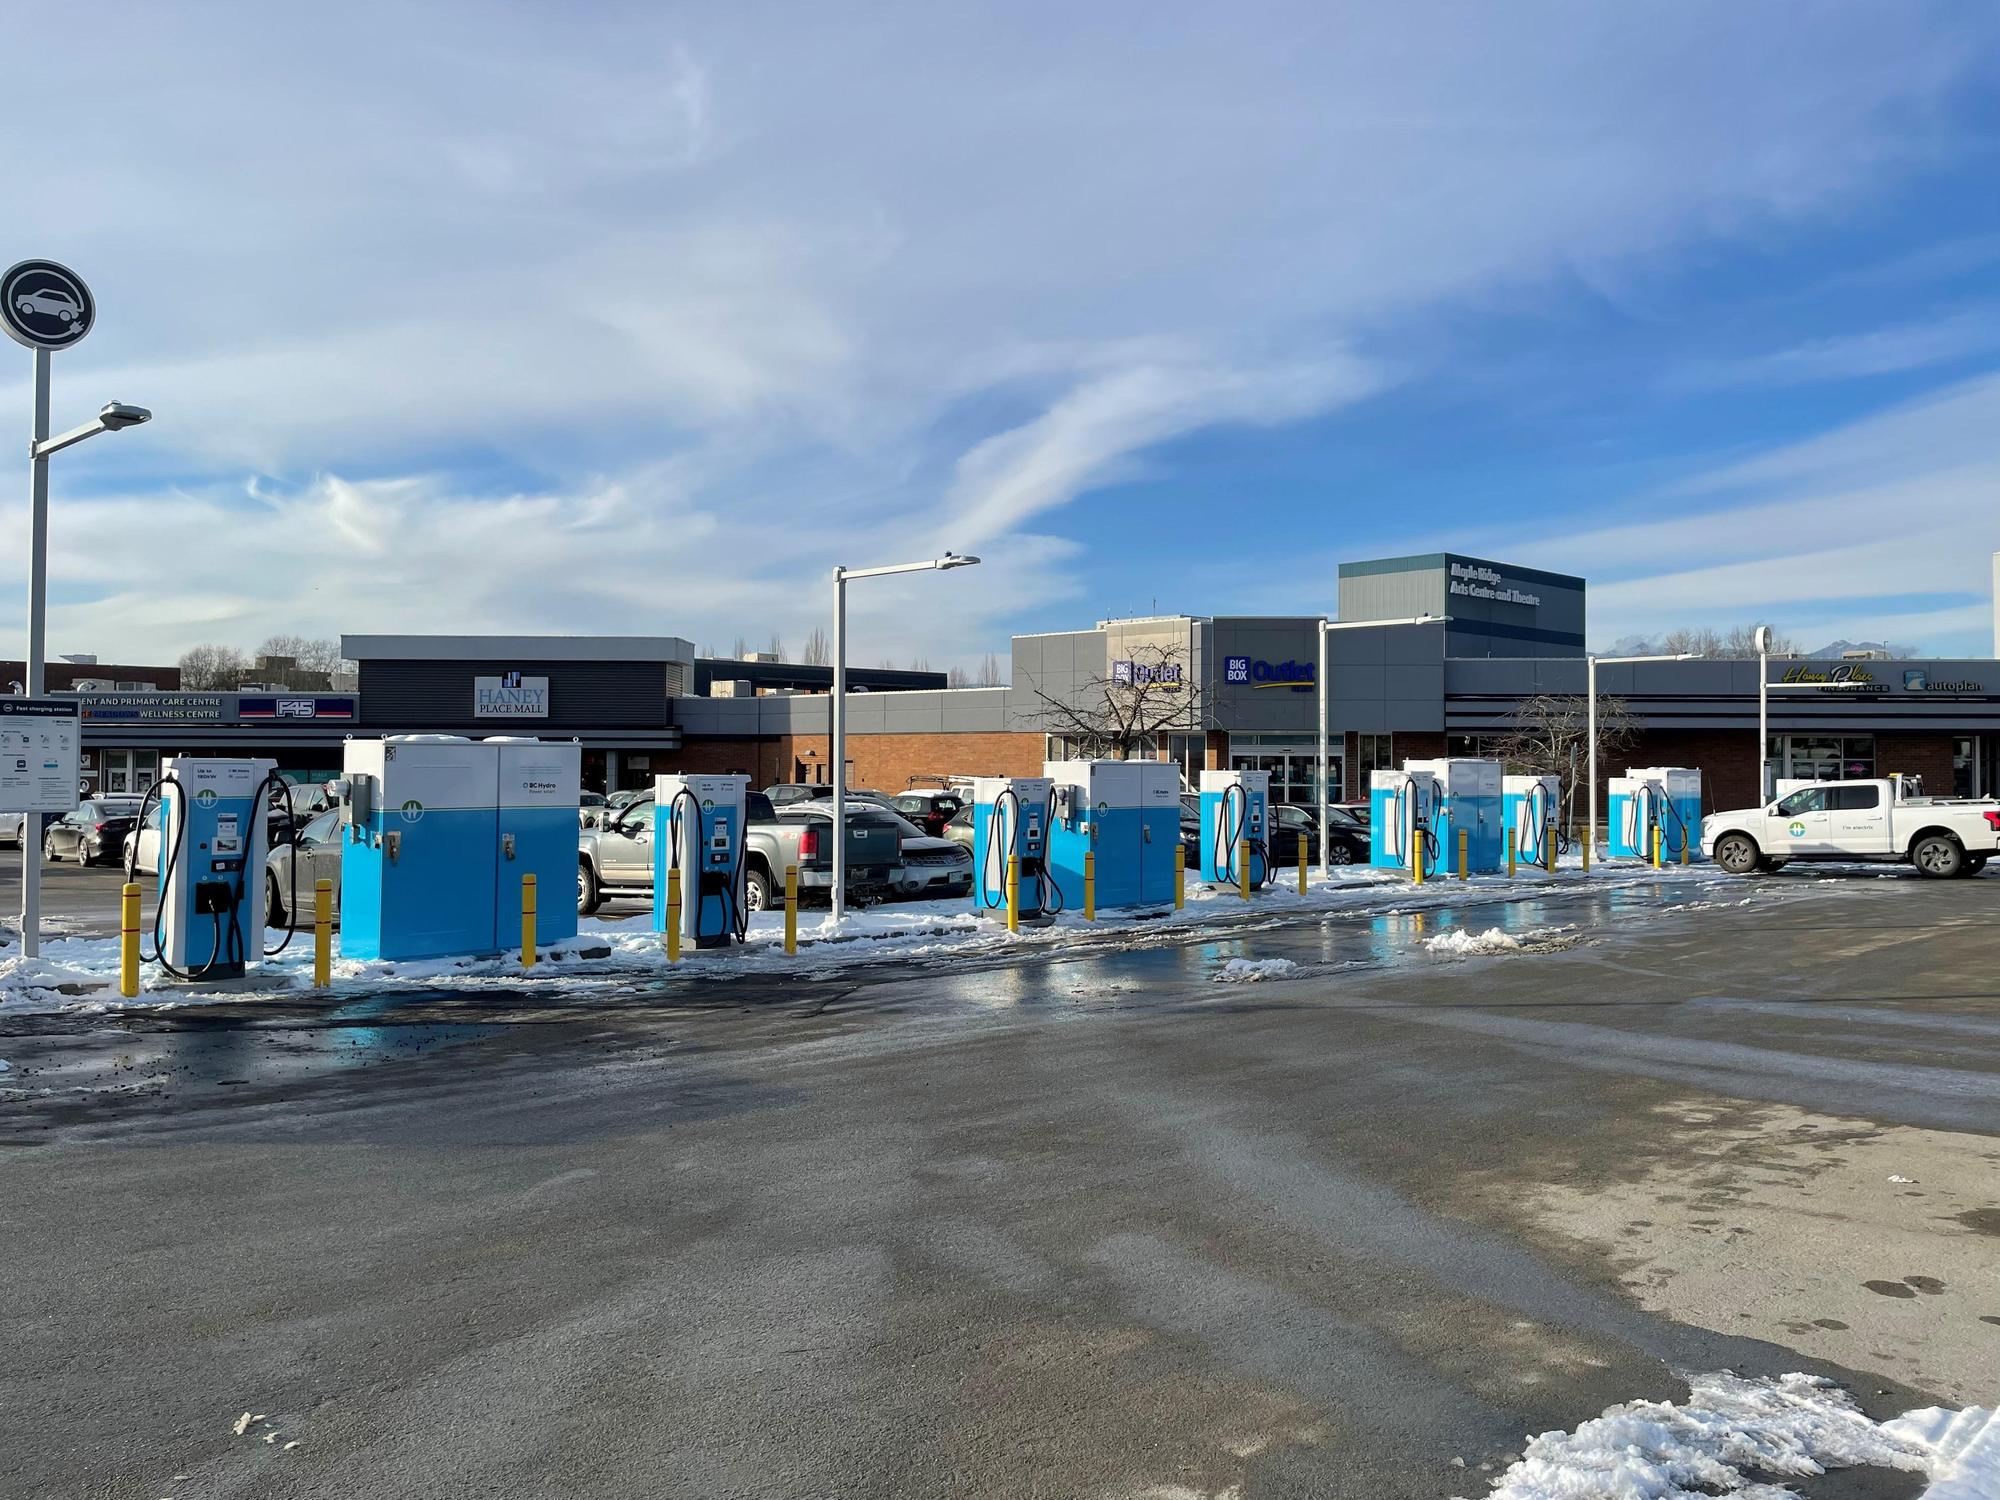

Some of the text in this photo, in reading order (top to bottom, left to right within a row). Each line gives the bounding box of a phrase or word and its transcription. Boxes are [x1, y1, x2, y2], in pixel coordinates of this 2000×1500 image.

[1450, 563, 1501, 585] Maple Ridge
[1450, 581, 1540, 606] Arts Centre and Theatre
[1116, 663, 1129, 674] BIG
[1229, 659, 1246, 669] BIG
[1227, 670, 1247, 681] BOX
[1253, 660, 1315, 681] Outlet
[1927, 680, 1983, 693] autoplan
[100, 698, 119, 706] AND
[120, 698, 160, 706] PRIMARY
[162, 698, 185, 706] CARE
[187, 698, 221, 706] CENTRE
[478, 688, 545, 704] HANEY
[140, 710, 185, 718] WELLNESS
[186, 710, 220, 718] CENTRE
[277, 700, 314, 716] F45
[480, 704, 544, 713] PLACE MALL
